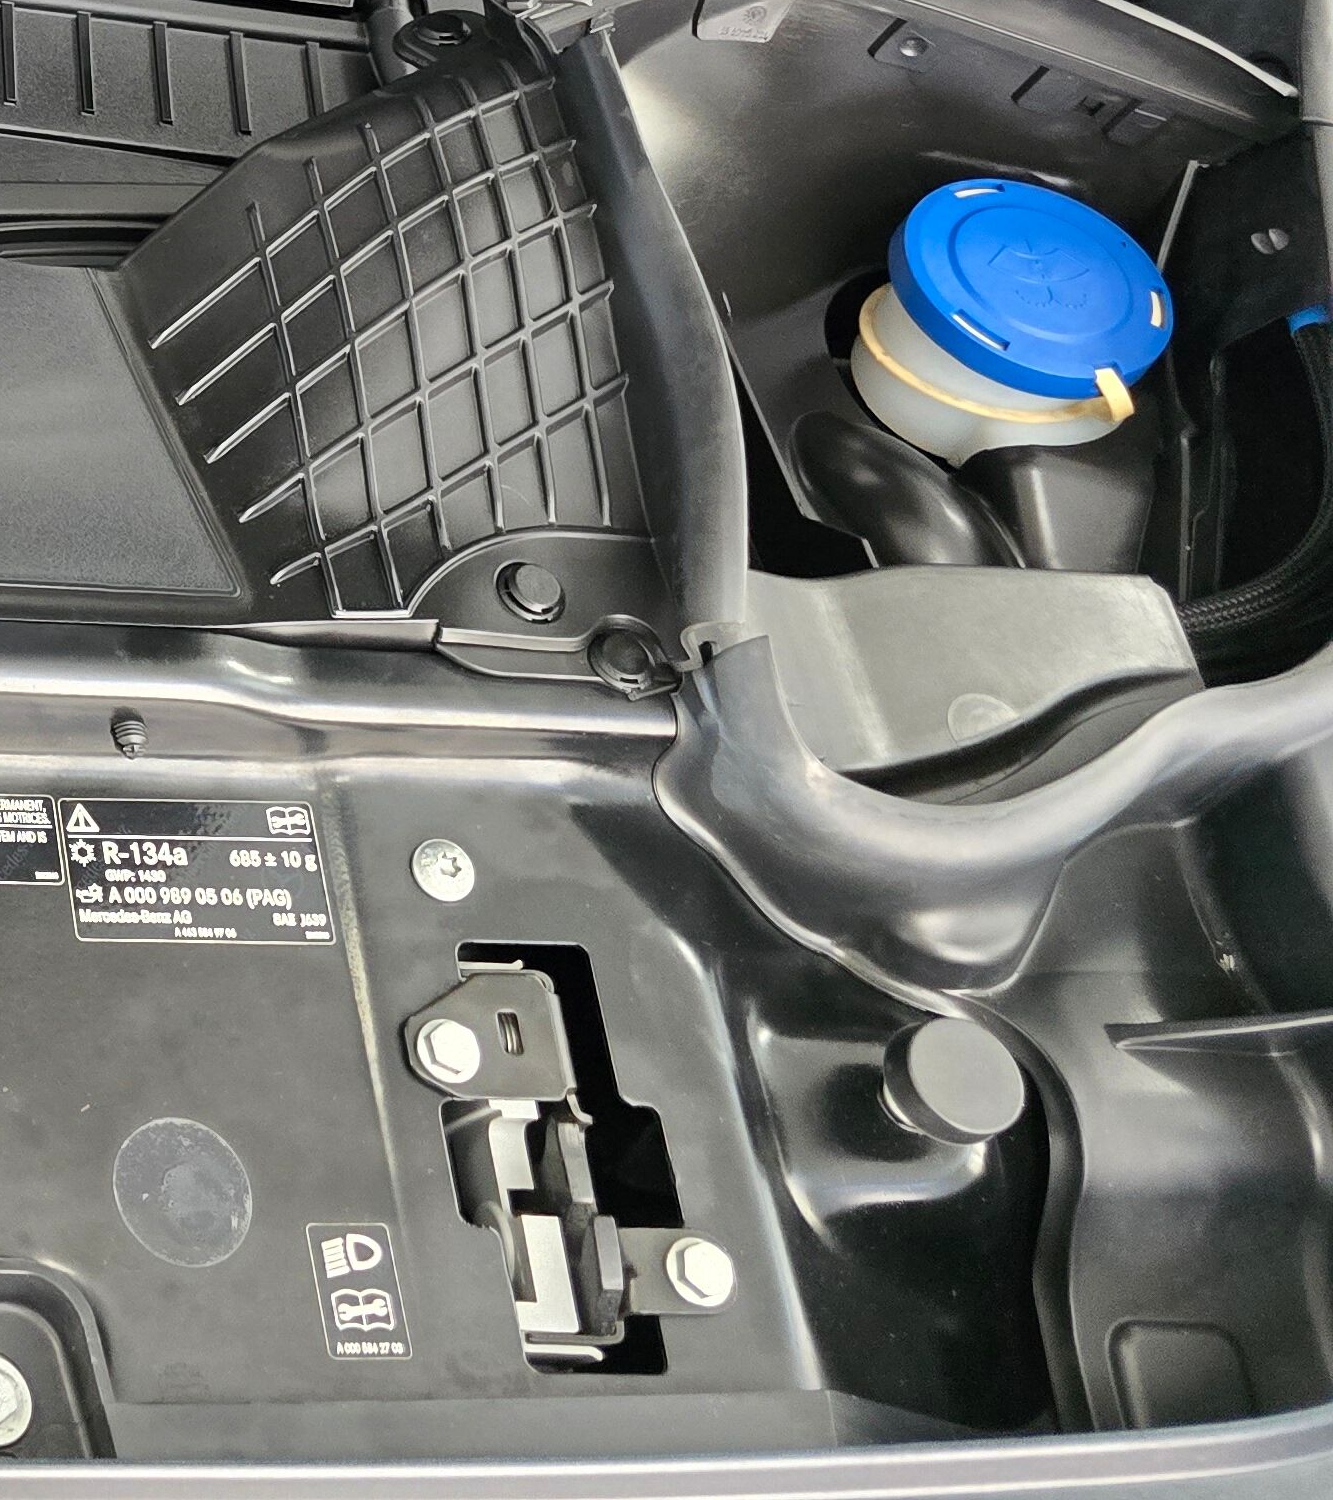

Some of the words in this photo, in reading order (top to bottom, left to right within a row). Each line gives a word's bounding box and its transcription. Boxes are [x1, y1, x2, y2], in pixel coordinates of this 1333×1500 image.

[17, 832, 36, 843] AND
[37, 832, 47, 844] IS
[102, 841, 189, 866] R-134a
[229, 850, 261, 867] 685
[281, 850, 302, 868] 10
[305, 854, 317, 872] g
[109, 886, 123, 904] A
[124, 886, 157, 904] 000
[160, 888, 192, 905] 989
[195, 888, 218, 906] 05
[220, 889, 243, 906] 06
[245, 888, 293, 910] (PAG)
[79, 908, 171, 924] Mercedes-Benz
[173, 910, 193, 925] AG
